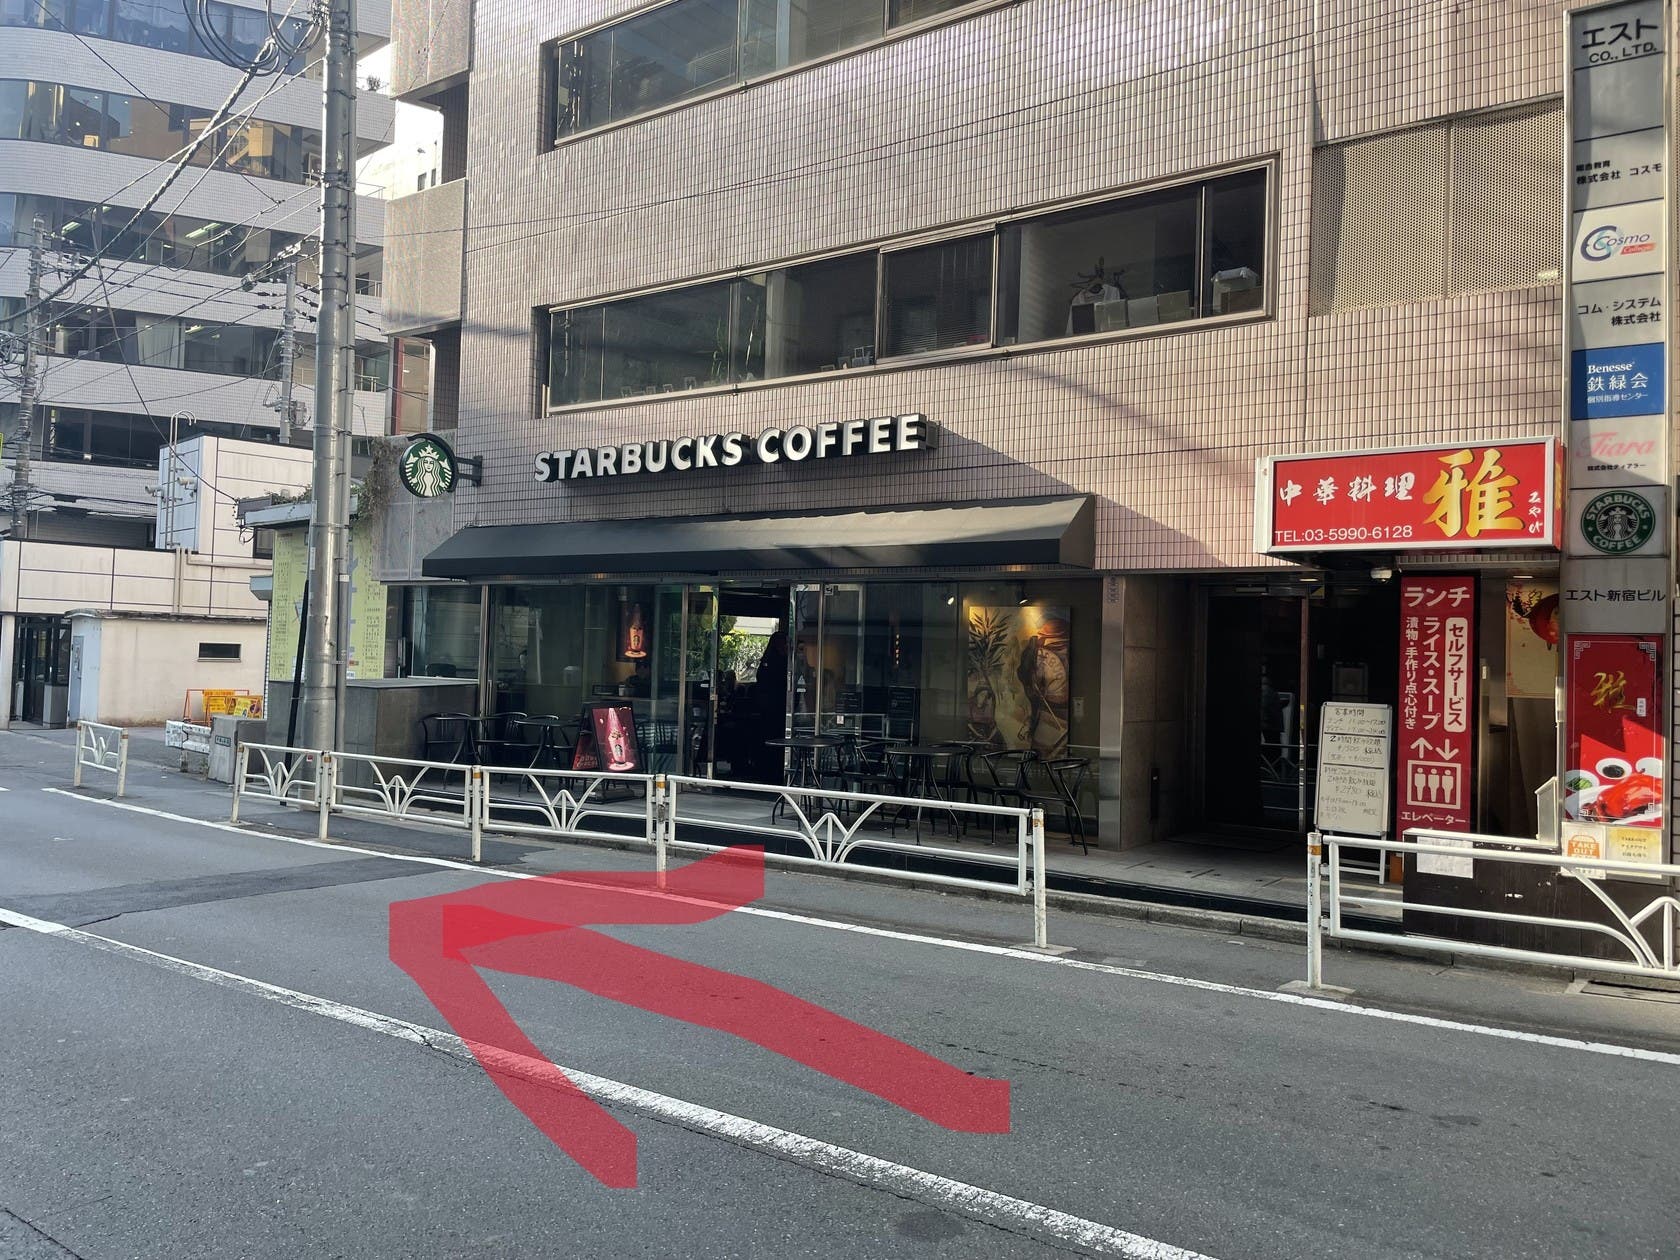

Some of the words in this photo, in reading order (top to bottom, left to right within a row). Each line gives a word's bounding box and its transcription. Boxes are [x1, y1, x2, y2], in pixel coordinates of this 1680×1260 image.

[1581, 18, 1659, 49] エスト
[1588, 52, 1619, 64] CO.,
[1622, 42, 1658, 57] LTD.
[1576, 170, 1621, 185] 株式会社
[1629, 163, 1663, 176] コスモ
[1577, 297, 1662, 315] コム・システム
[1611, 311, 1661, 327] 株式会社
[1587, 362, 1634, 374] Benesse
[1586, 372, 1649, 392] 鉄緑会
[534, 432, 744, 482] STARBUCKS
[757, 413, 924, 463] COFFEE
[1576, 431, 1657, 459] Tiara
[1279, 471, 1416, 507] 中華料理
[1422, 448, 1526, 538] 雅
[1586, 494, 1650, 521] STARBUCKS
[1274, 525, 1413, 543] TEL:03-5990-6128
[1592, 535, 1642, 551] COFFEE
[1404, 586, 1471, 608] ランチ
[1565, 589, 1666, 603] エスト新宿ビル
[1422, 616, 1441, 731] ライス・スープ
[1447, 624, 1465, 727] セルフサービス
[1400, 811, 1467, 825] エレベーター
[1571, 841, 1597, 849] TAKE
[1573, 848, 1594, 856] OUT
